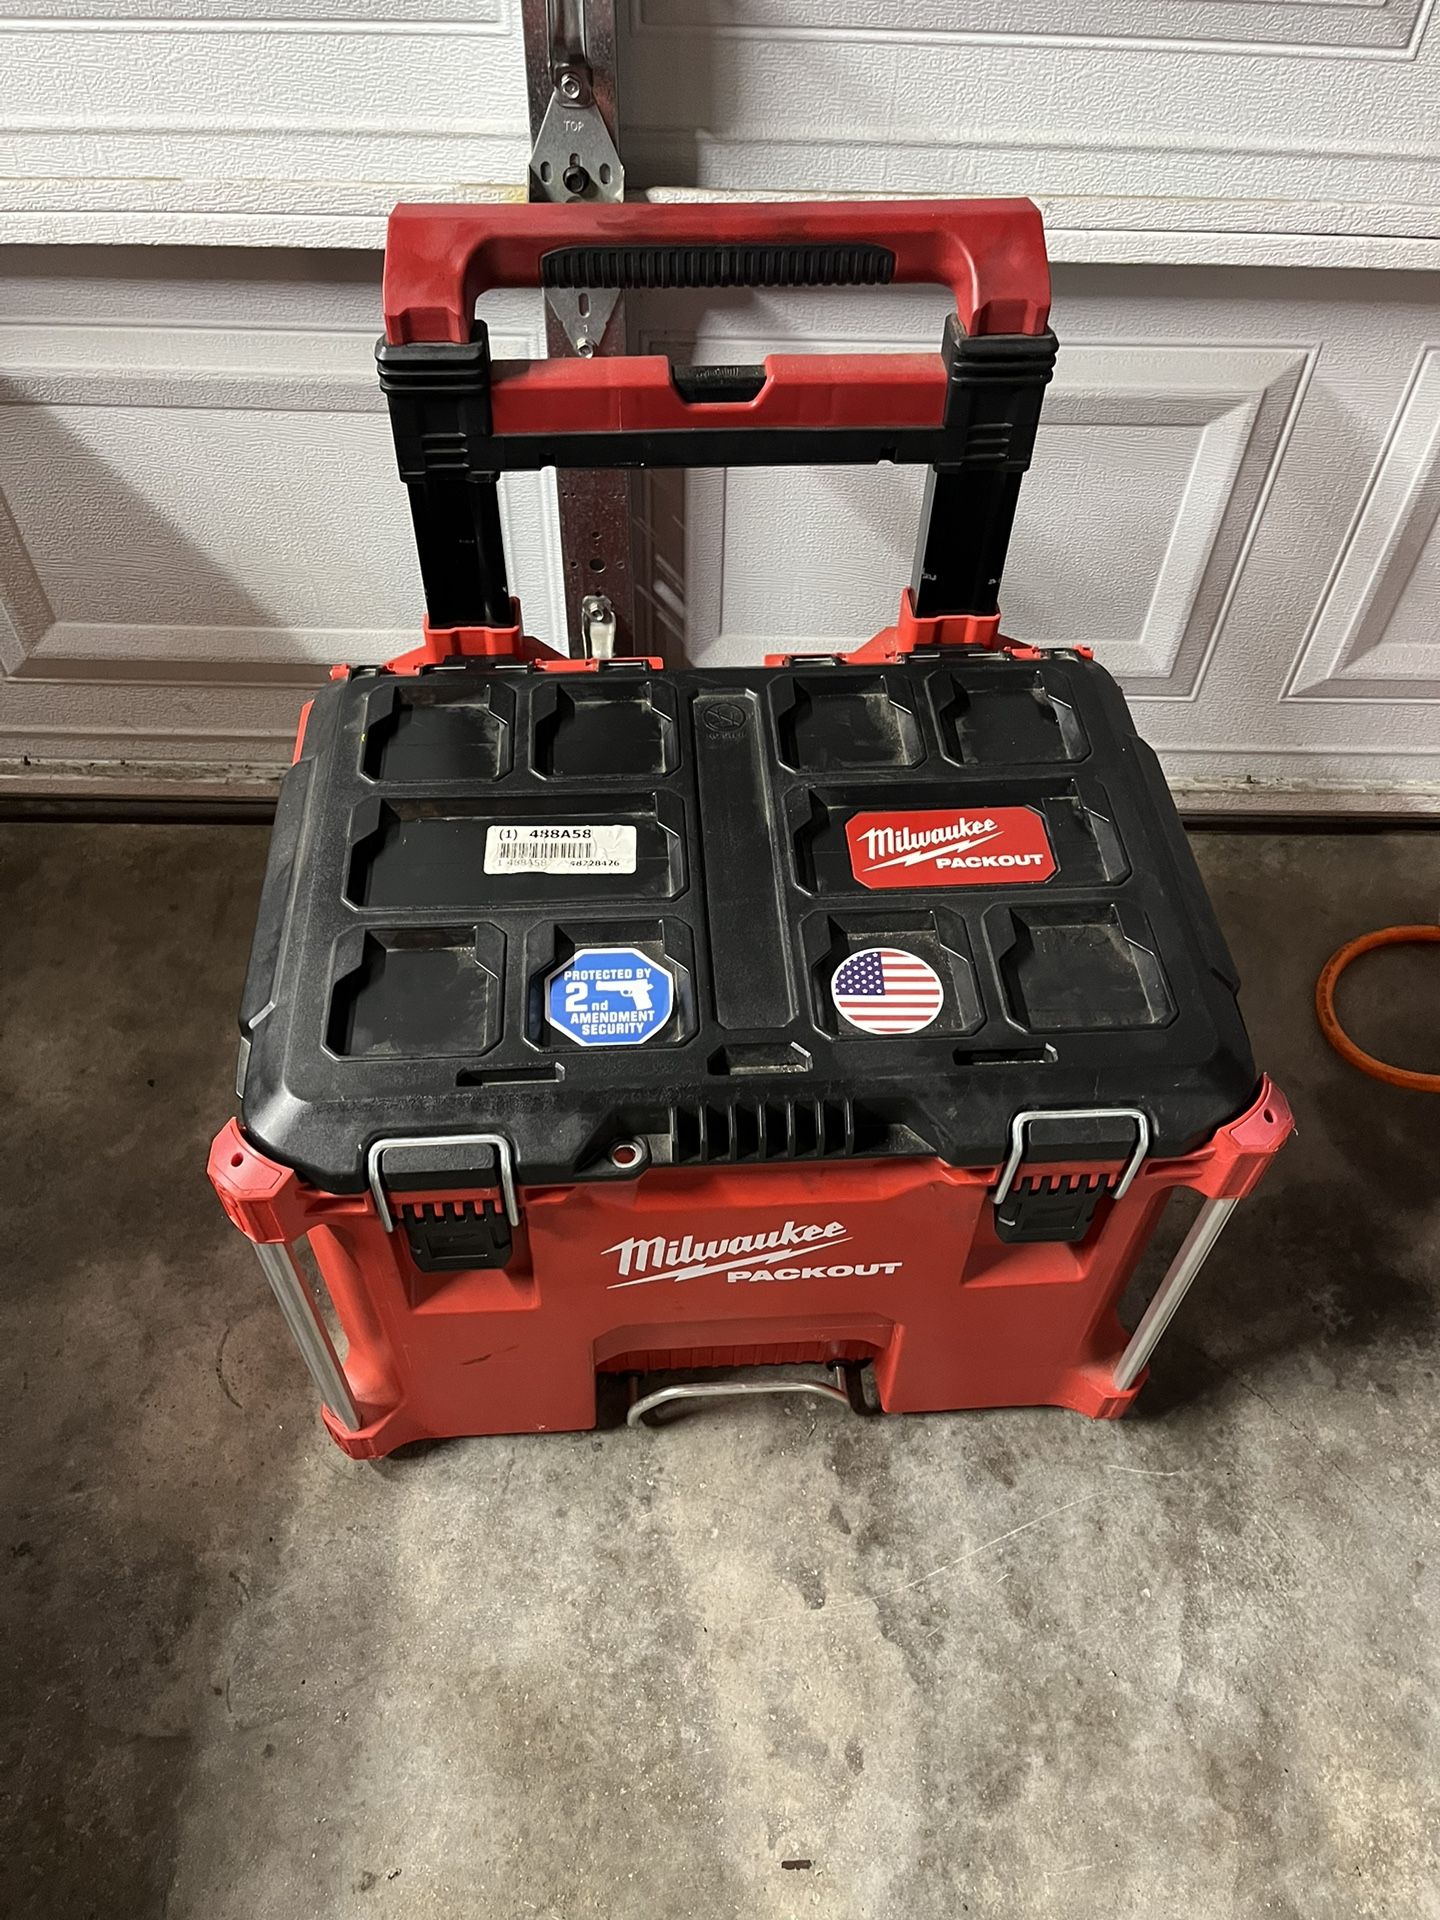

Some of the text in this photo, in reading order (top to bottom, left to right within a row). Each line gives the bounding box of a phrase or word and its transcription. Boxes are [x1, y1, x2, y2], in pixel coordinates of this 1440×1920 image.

[563, 120, 585, 132] TOP
[499, 829, 518, 841] (1)
[856, 817, 998, 861] Milwaukee
[935, 854, 1044, 869] PACKOUT
[564, 968, 652, 981] PROTECTED BY
[570, 1010, 655, 1025] AMENDMENT
[582, 1022, 644, 1036] SECURITY
[601, 1221, 847, 1275] Milwaukee
[727, 1262, 903, 1283] PACKOUT
